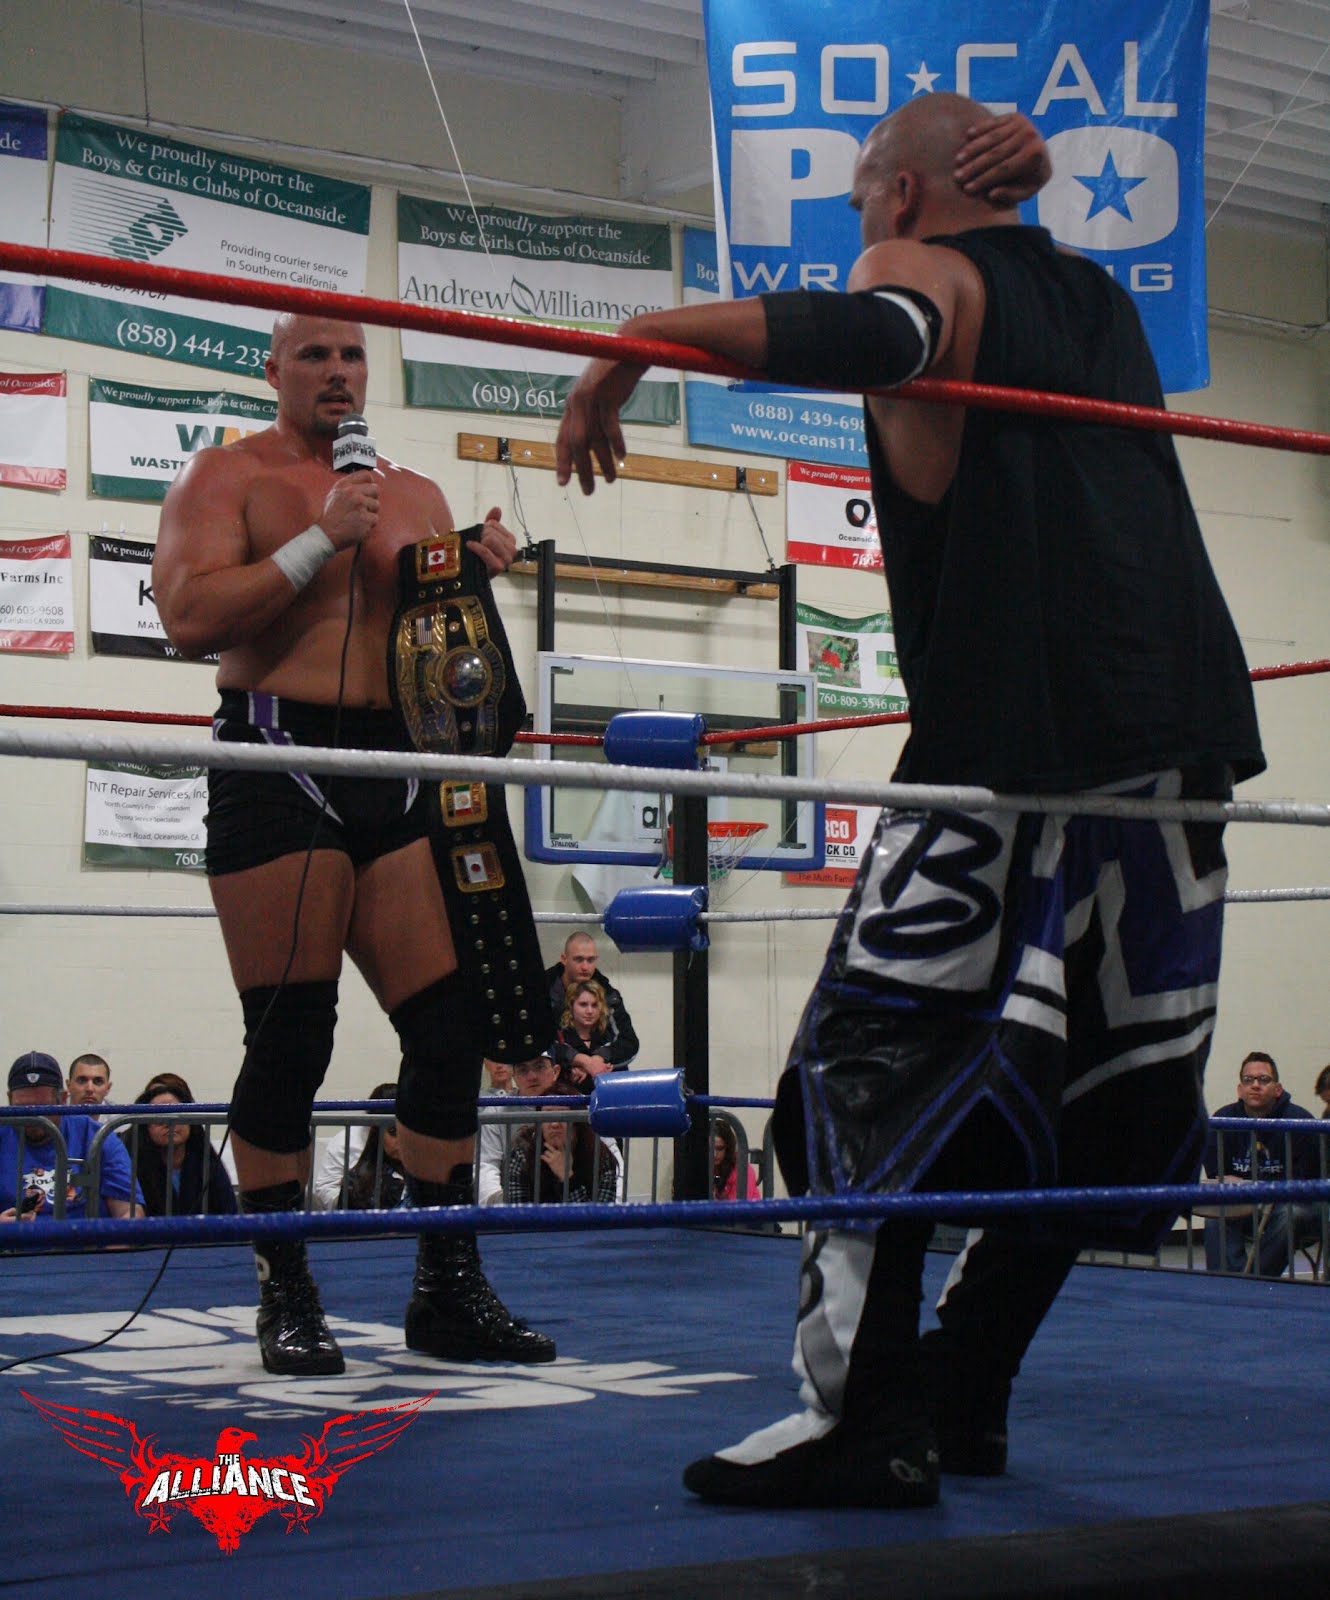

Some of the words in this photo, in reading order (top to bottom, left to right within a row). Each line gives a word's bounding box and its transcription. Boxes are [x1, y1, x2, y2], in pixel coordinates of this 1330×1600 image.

[732, 41, 889, 117] SO
[955, 41, 1178, 118] CAL
[116, 132, 148, 153] We
[151, 144, 216, 174] proudly
[220, 162, 284, 186] support
[288, 175, 315, 194] the
[82, 148, 121, 172] Boys
[125, 159, 144, 176] &
[148, 166, 188, 188] Girls
[193, 175, 241, 200] Clubs
[244, 188, 262, 205] of
[264, 192, 347, 225] Oceanside
[730, 126, 1178, 251] PO
[446, 207, 475, 224] We
[479, 213, 537, 237] proudly
[540, 223, 594, 240] support
[598, 223, 622, 240] the
[220, 240, 271, 262] Providing
[273, 253, 311, 269] courier
[313, 262, 349, 278] service
[420, 225, 456, 247] Boys
[459, 231, 476, 246] &
[478, 233, 515, 251] Girls
[517, 239, 560, 257] Clubs
[563, 241, 578, 257] of
[579, 244, 651, 264] Oceanside
[226, 257, 236, 268] in
[239, 260, 287, 280] Southern
[289, 271, 338, 292] California
[696, 262, 720, 287] Boy
[400, 275, 510, 310] Andrew
[116, 318, 177, 356] (858)
[183, 334, 271, 369] 444-235
[10, 379, 56, 388] Oceanside
[472, 381, 520, 411] (619)
[525, 388, 566, 408] 661-
[101, 386, 118, 397] We
[119, 391, 156, 404] proudly
[157, 395, 190, 406] support
[191, 396, 206, 407] the
[207, 397, 228, 410] Boys
[239, 400, 261, 413] Girls
[262, 404, 279, 414] Clu
[748, 401, 794, 424] (888)
[799, 410, 866, 433] 439-698
[730, 423, 869, 454] www.oceans11.c
[800, 467, 810, 476] We
[811, 470, 838, 482] proudly
[840, 473, 864, 484] support
[101, 543, 119, 553] We
[120, 547, 155, 560] proudly
[0, 572, 40, 584] Farms
[43, 572, 64, 584] Inc
[88, 780, 109, 793] TNT
[110, 783, 146, 798] Repair
[147, 787, 191, 800] Services,
[192, 788, 208, 799] Inc
